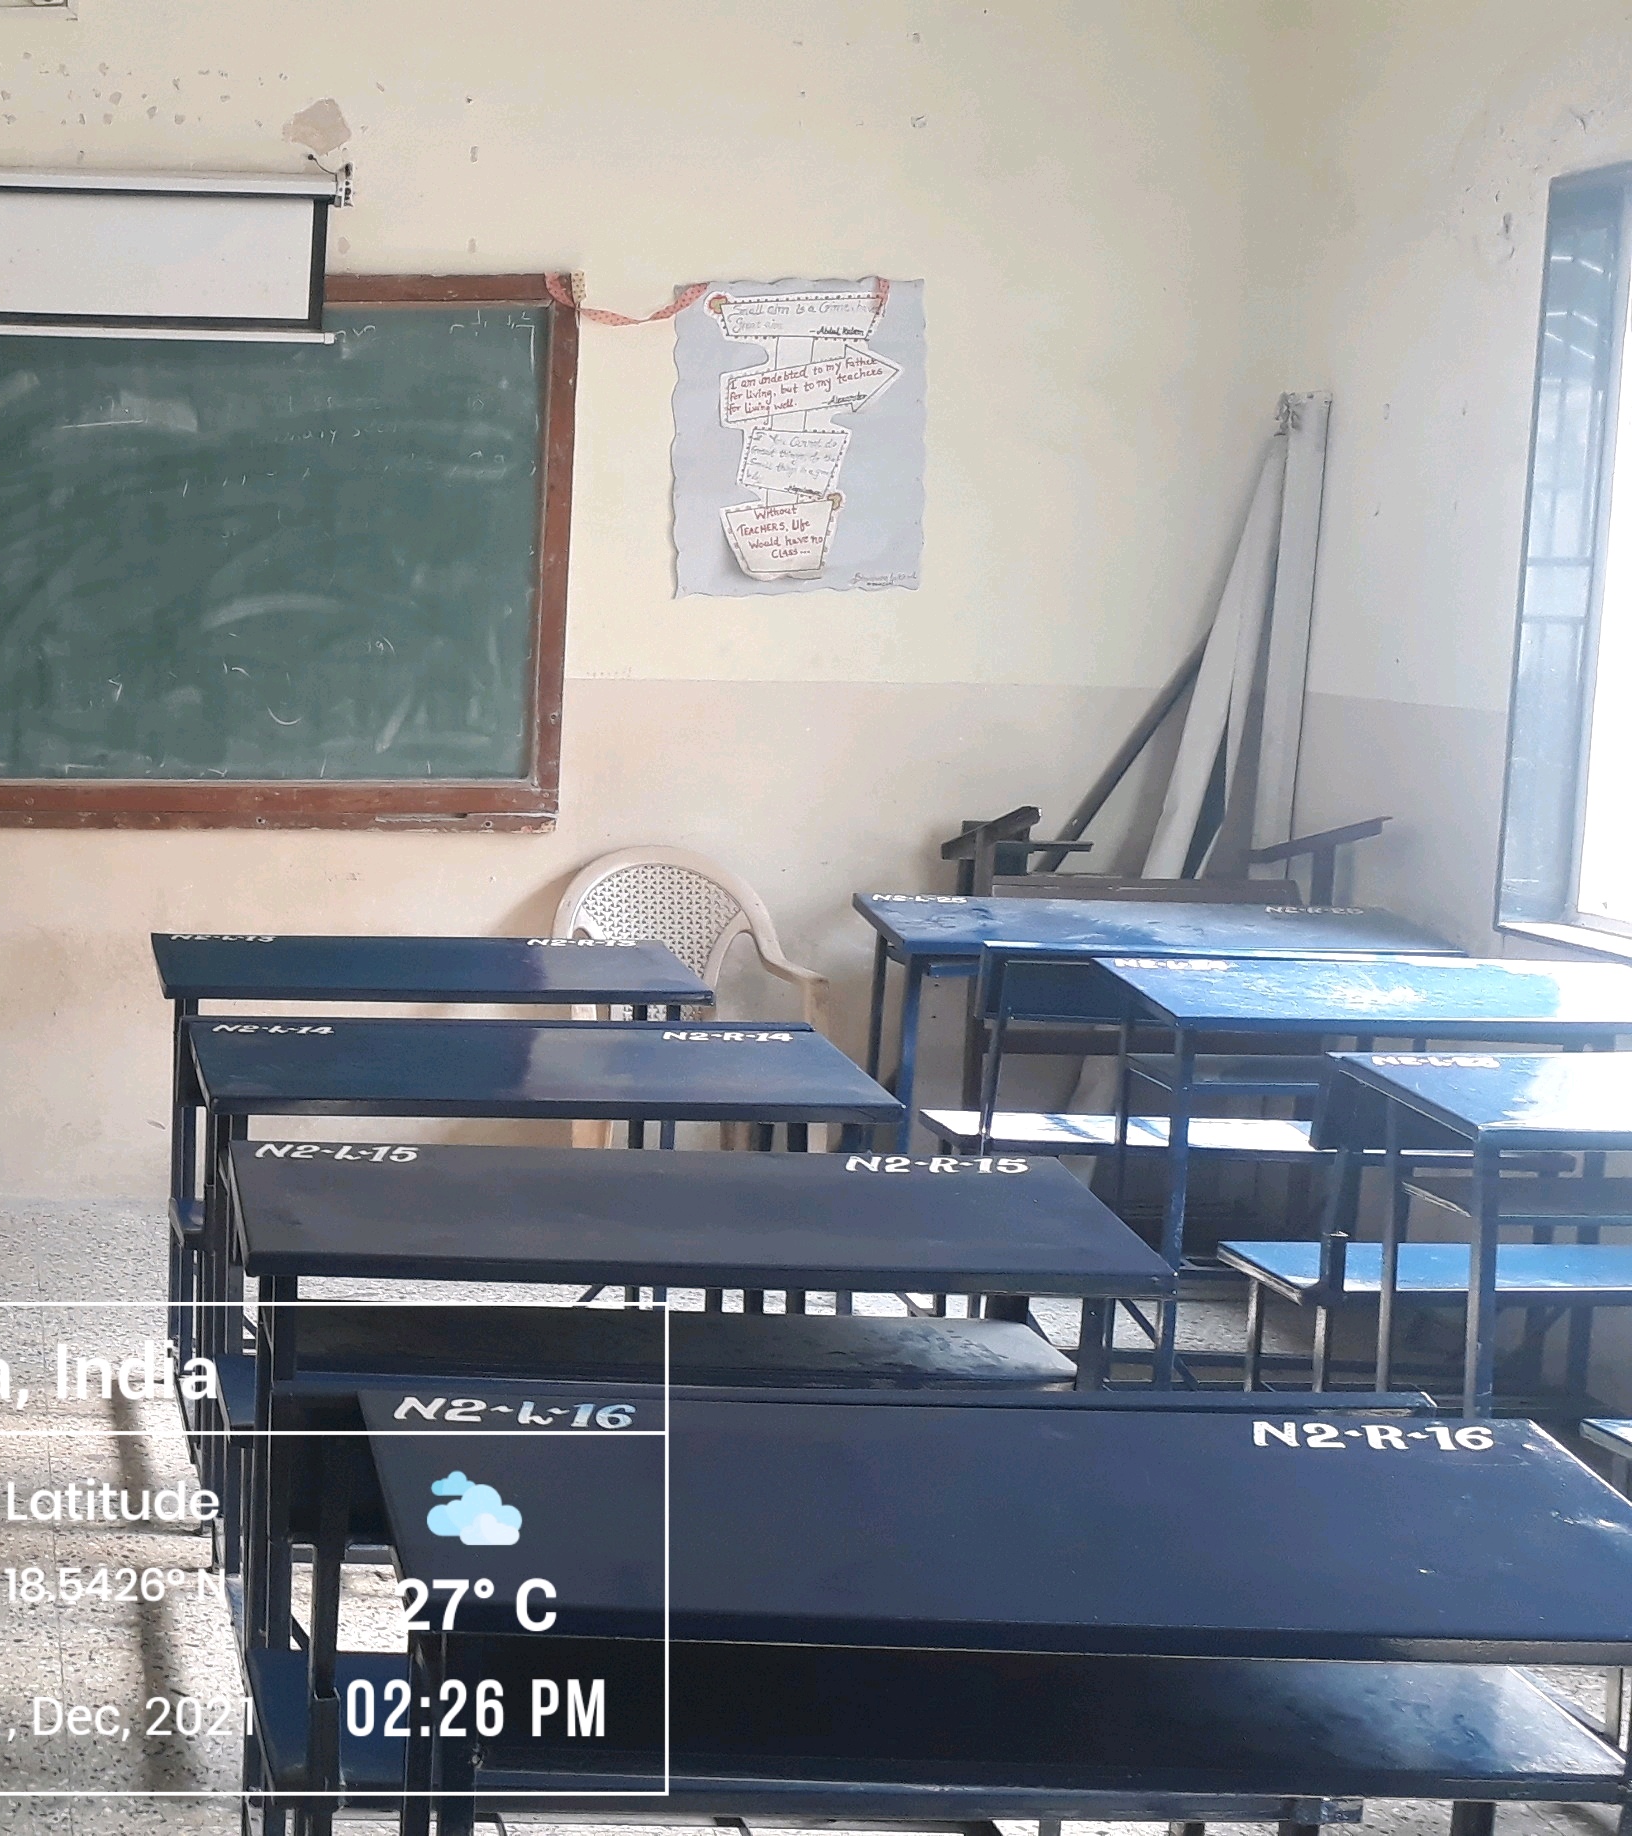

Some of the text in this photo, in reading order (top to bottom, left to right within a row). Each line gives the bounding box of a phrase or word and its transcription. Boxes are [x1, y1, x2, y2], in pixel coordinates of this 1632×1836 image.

[813, 366, 823, 375] to
[780, 383, 799, 395] but
[804, 382, 816, 391] to
